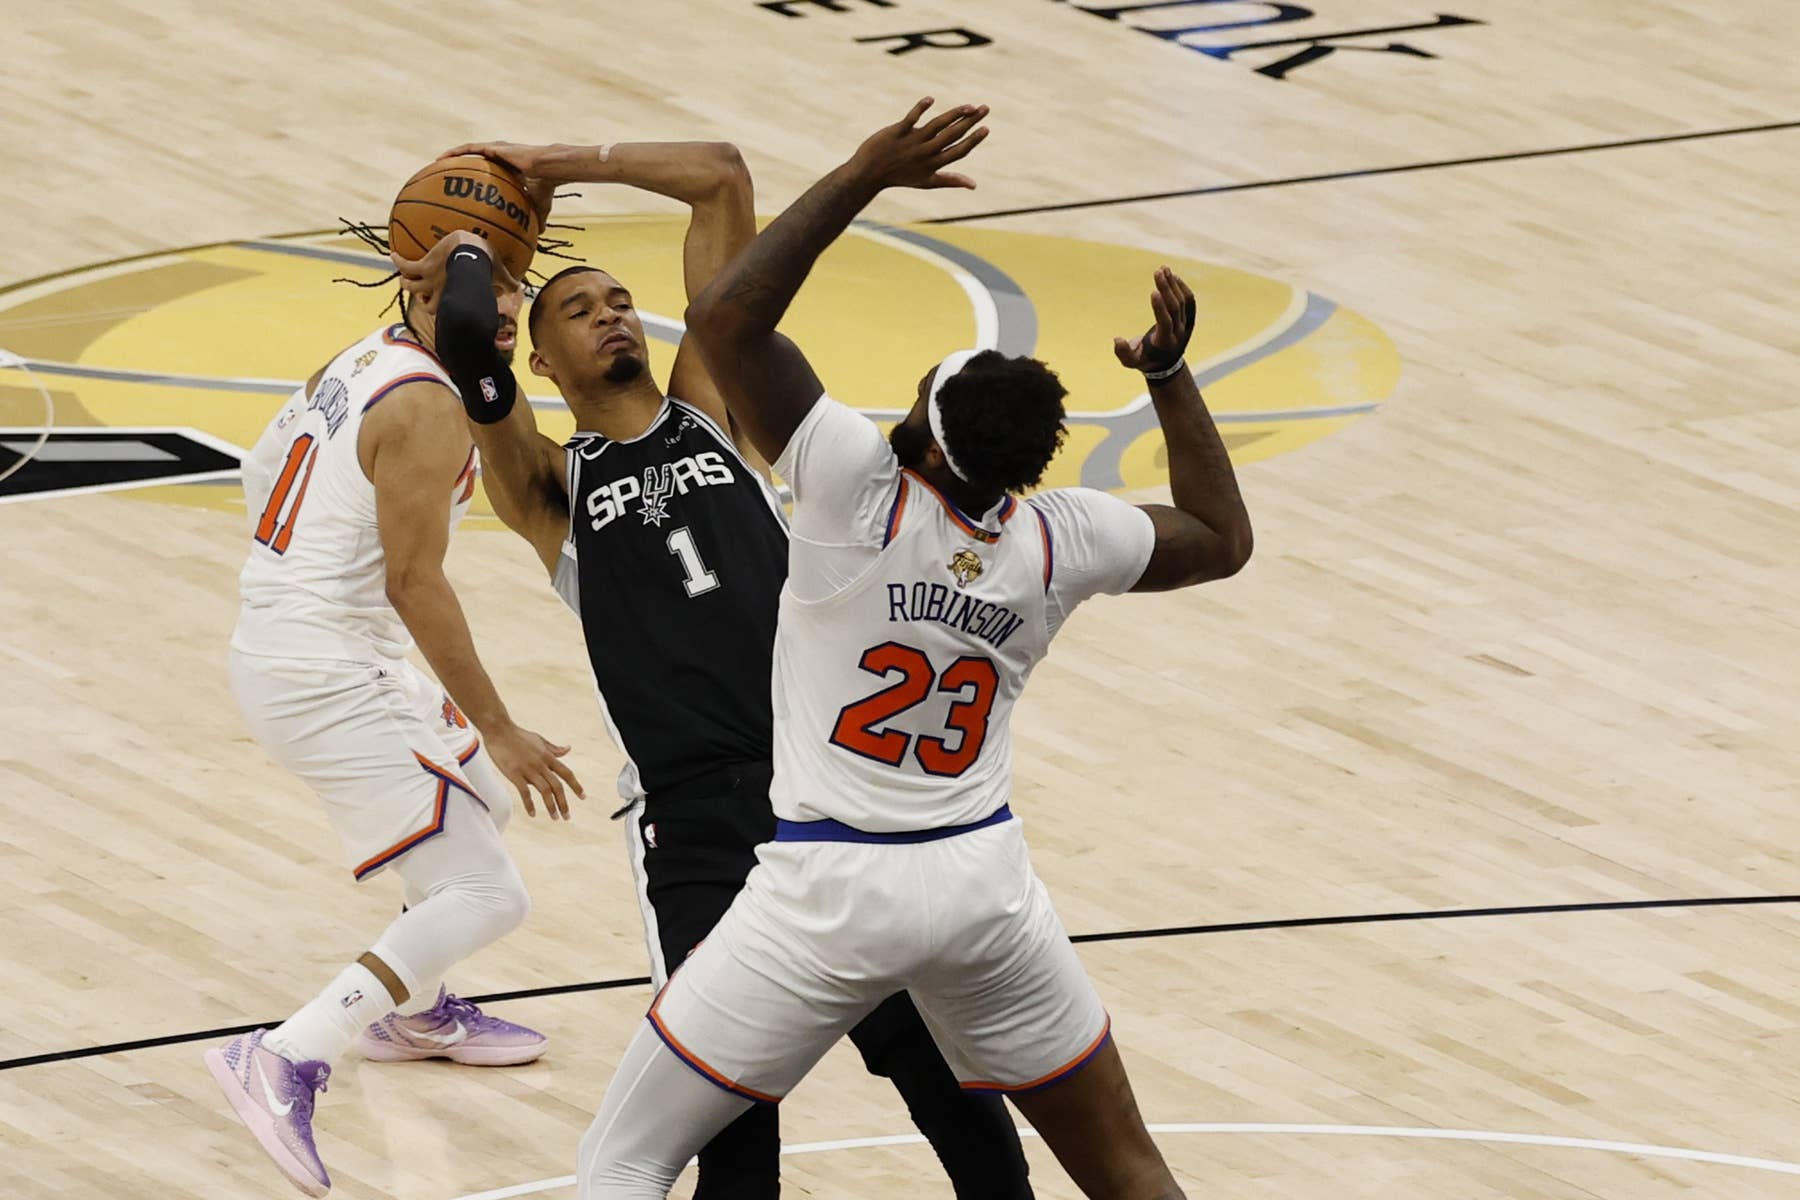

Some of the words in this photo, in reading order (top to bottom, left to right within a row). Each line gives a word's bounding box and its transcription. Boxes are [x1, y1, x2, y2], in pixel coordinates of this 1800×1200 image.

[442, 175, 530, 232] Wilson
[254, 432, 320, 556] 11
[586, 451, 735, 532] SPURS
[665, 526, 721, 599] 1
[887, 581, 1024, 649] ROBINSON
[829, 640, 1000, 778] 23
